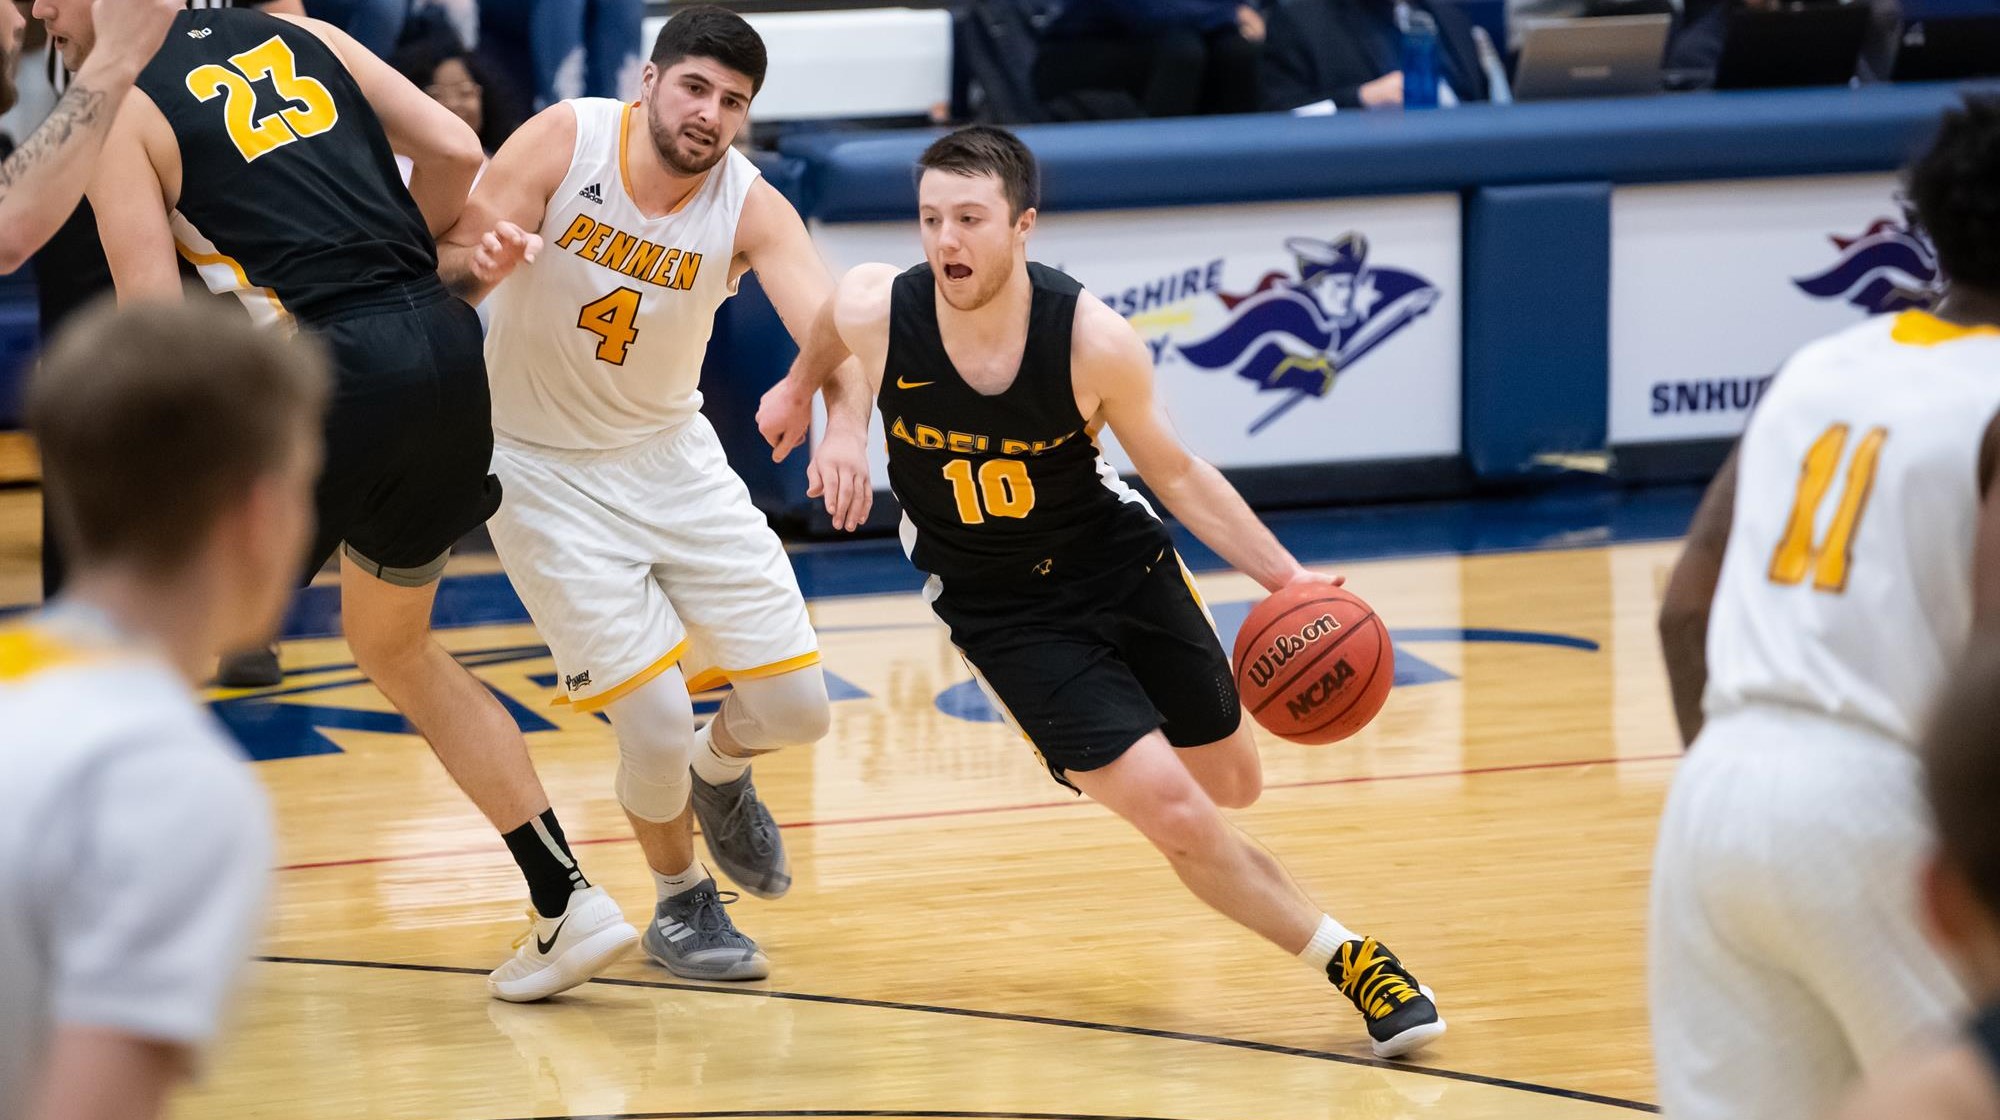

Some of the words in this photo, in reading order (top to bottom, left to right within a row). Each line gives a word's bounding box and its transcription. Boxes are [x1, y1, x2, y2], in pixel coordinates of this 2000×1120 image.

[185, 34, 339, 163] 23
[579, 190, 603, 205] adidas
[554, 213, 702, 290] PENMEN
[577, 286, 643, 366] 4
[891, 416, 1079, 454] ADELP
[942, 458, 1036, 525] 10
[1766, 422, 1889, 594] 11
[1248, 613, 1341, 688] Wilson
[1286, 658, 1356, 721] NCAA
